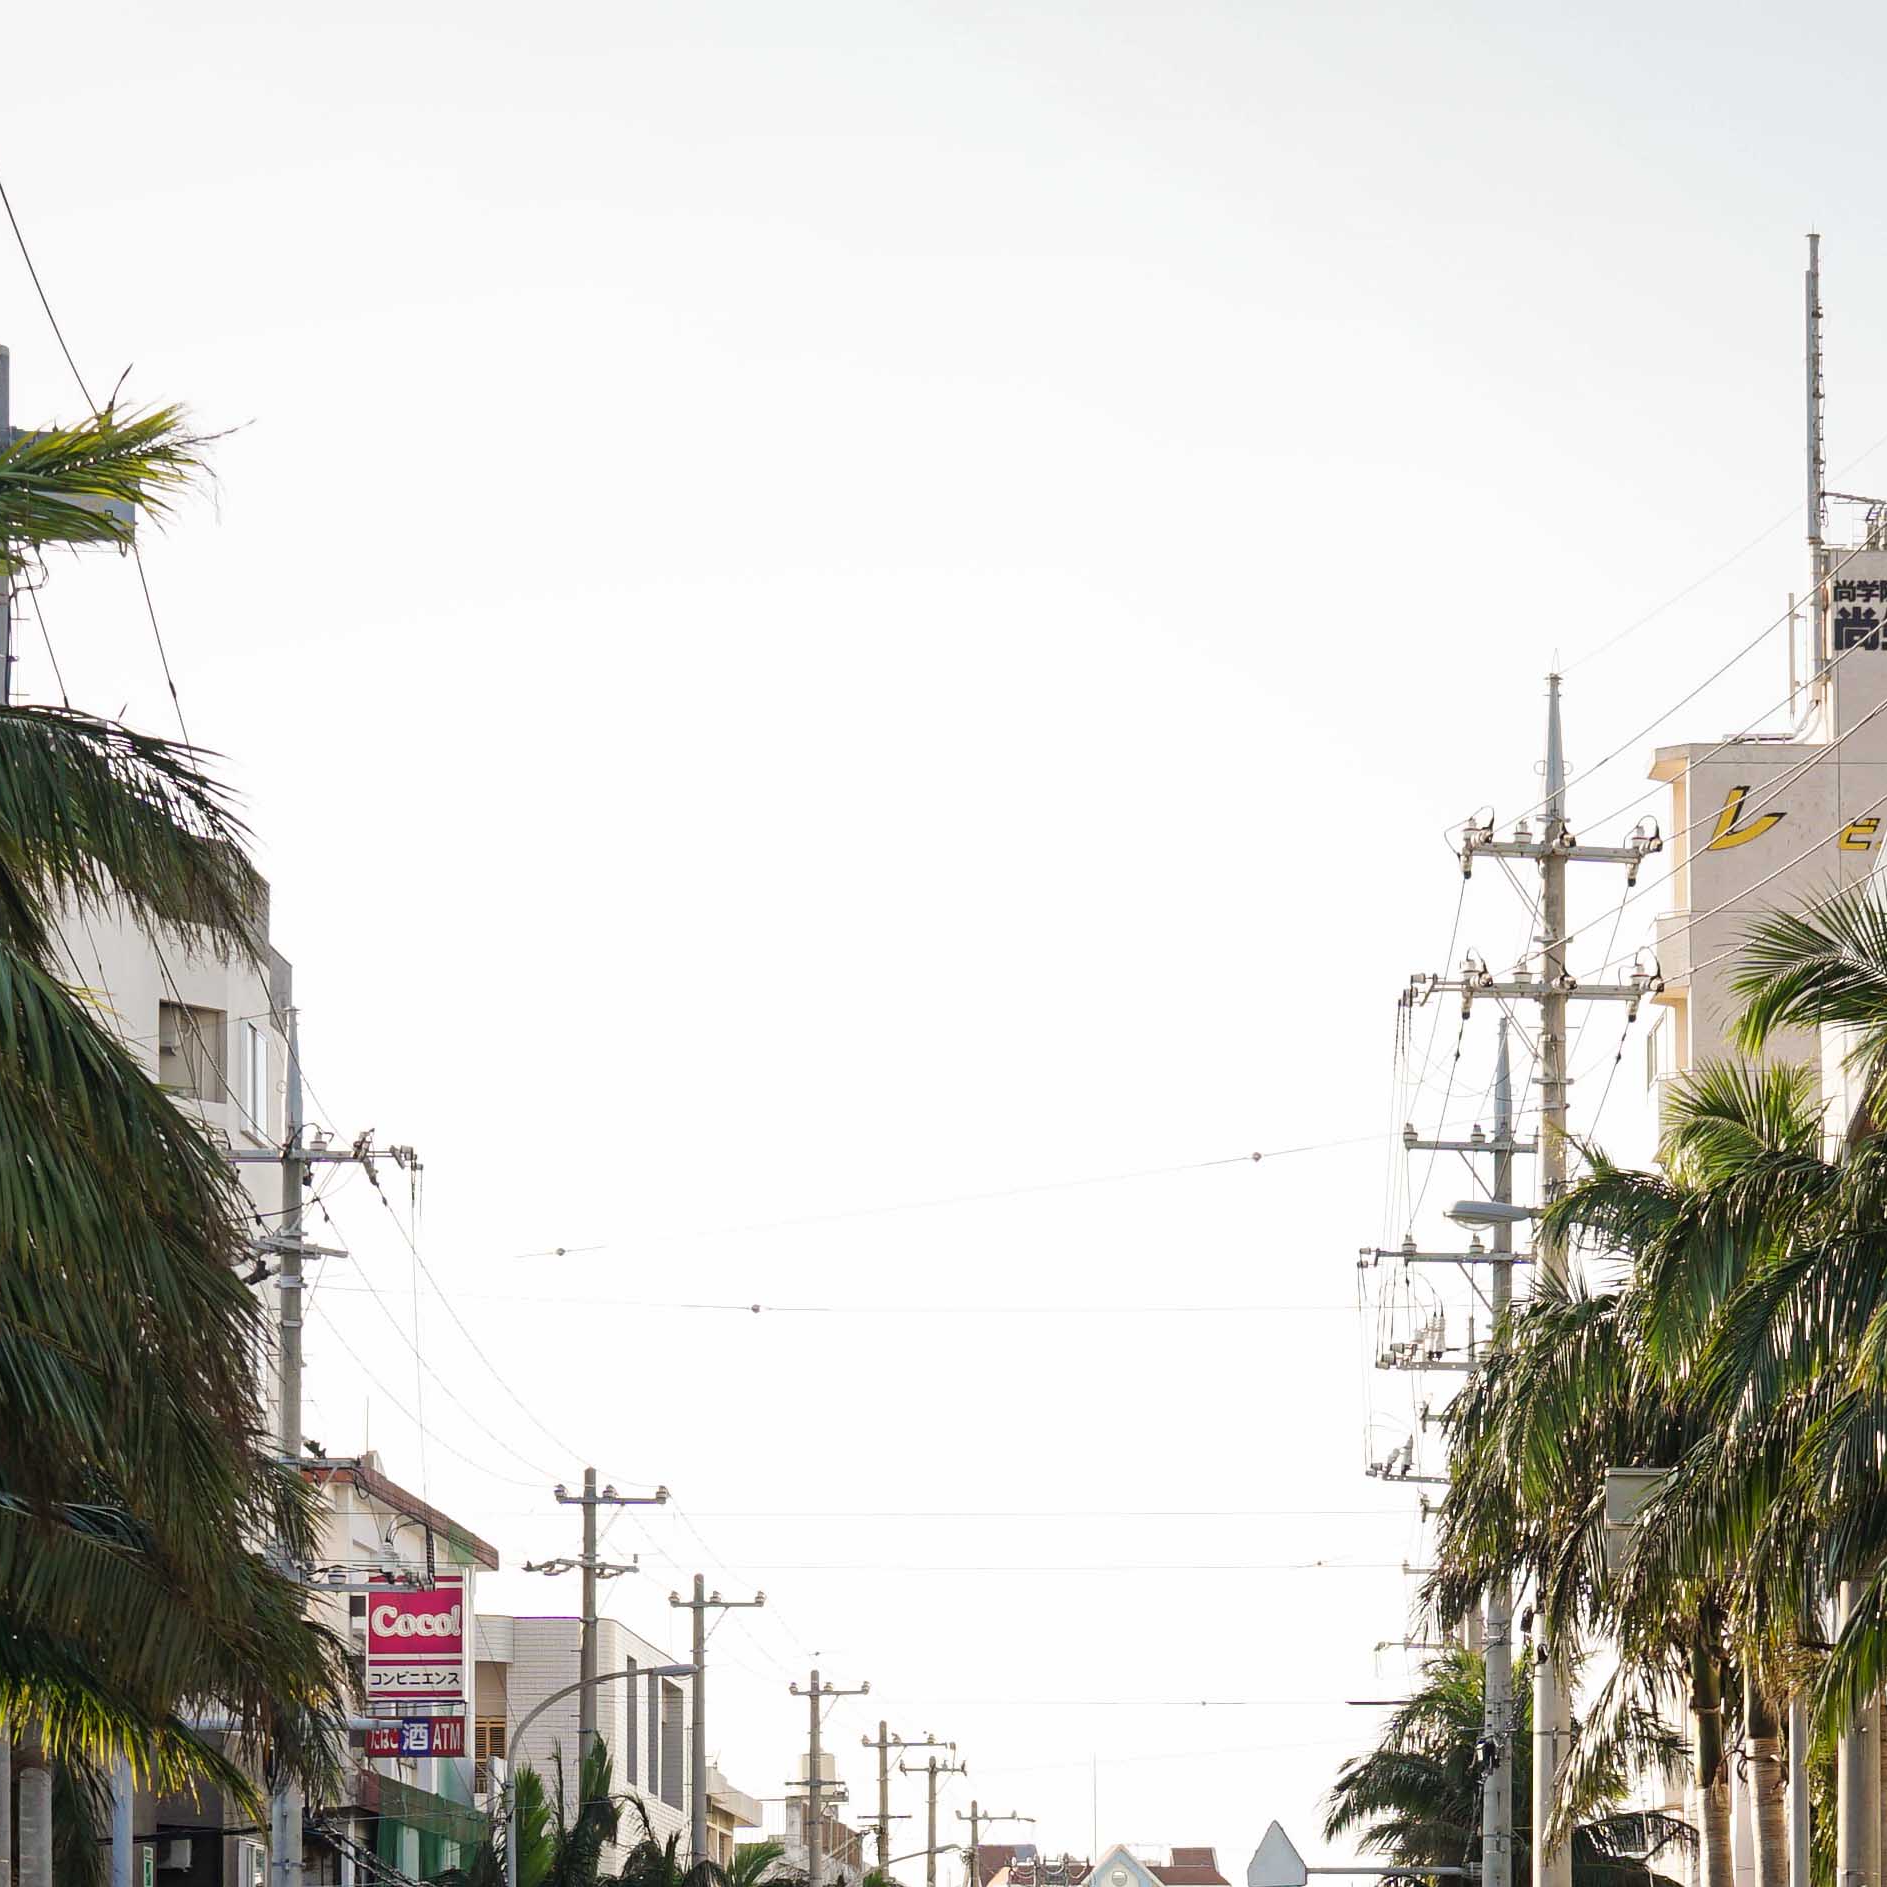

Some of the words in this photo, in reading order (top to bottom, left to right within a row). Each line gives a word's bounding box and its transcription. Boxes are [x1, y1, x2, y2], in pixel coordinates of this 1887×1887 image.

[371, 1672, 459, 1686] コンビニエンス
[402, 1723, 429, 1752] 酒
[433, 1723, 462, 1751] ATM
